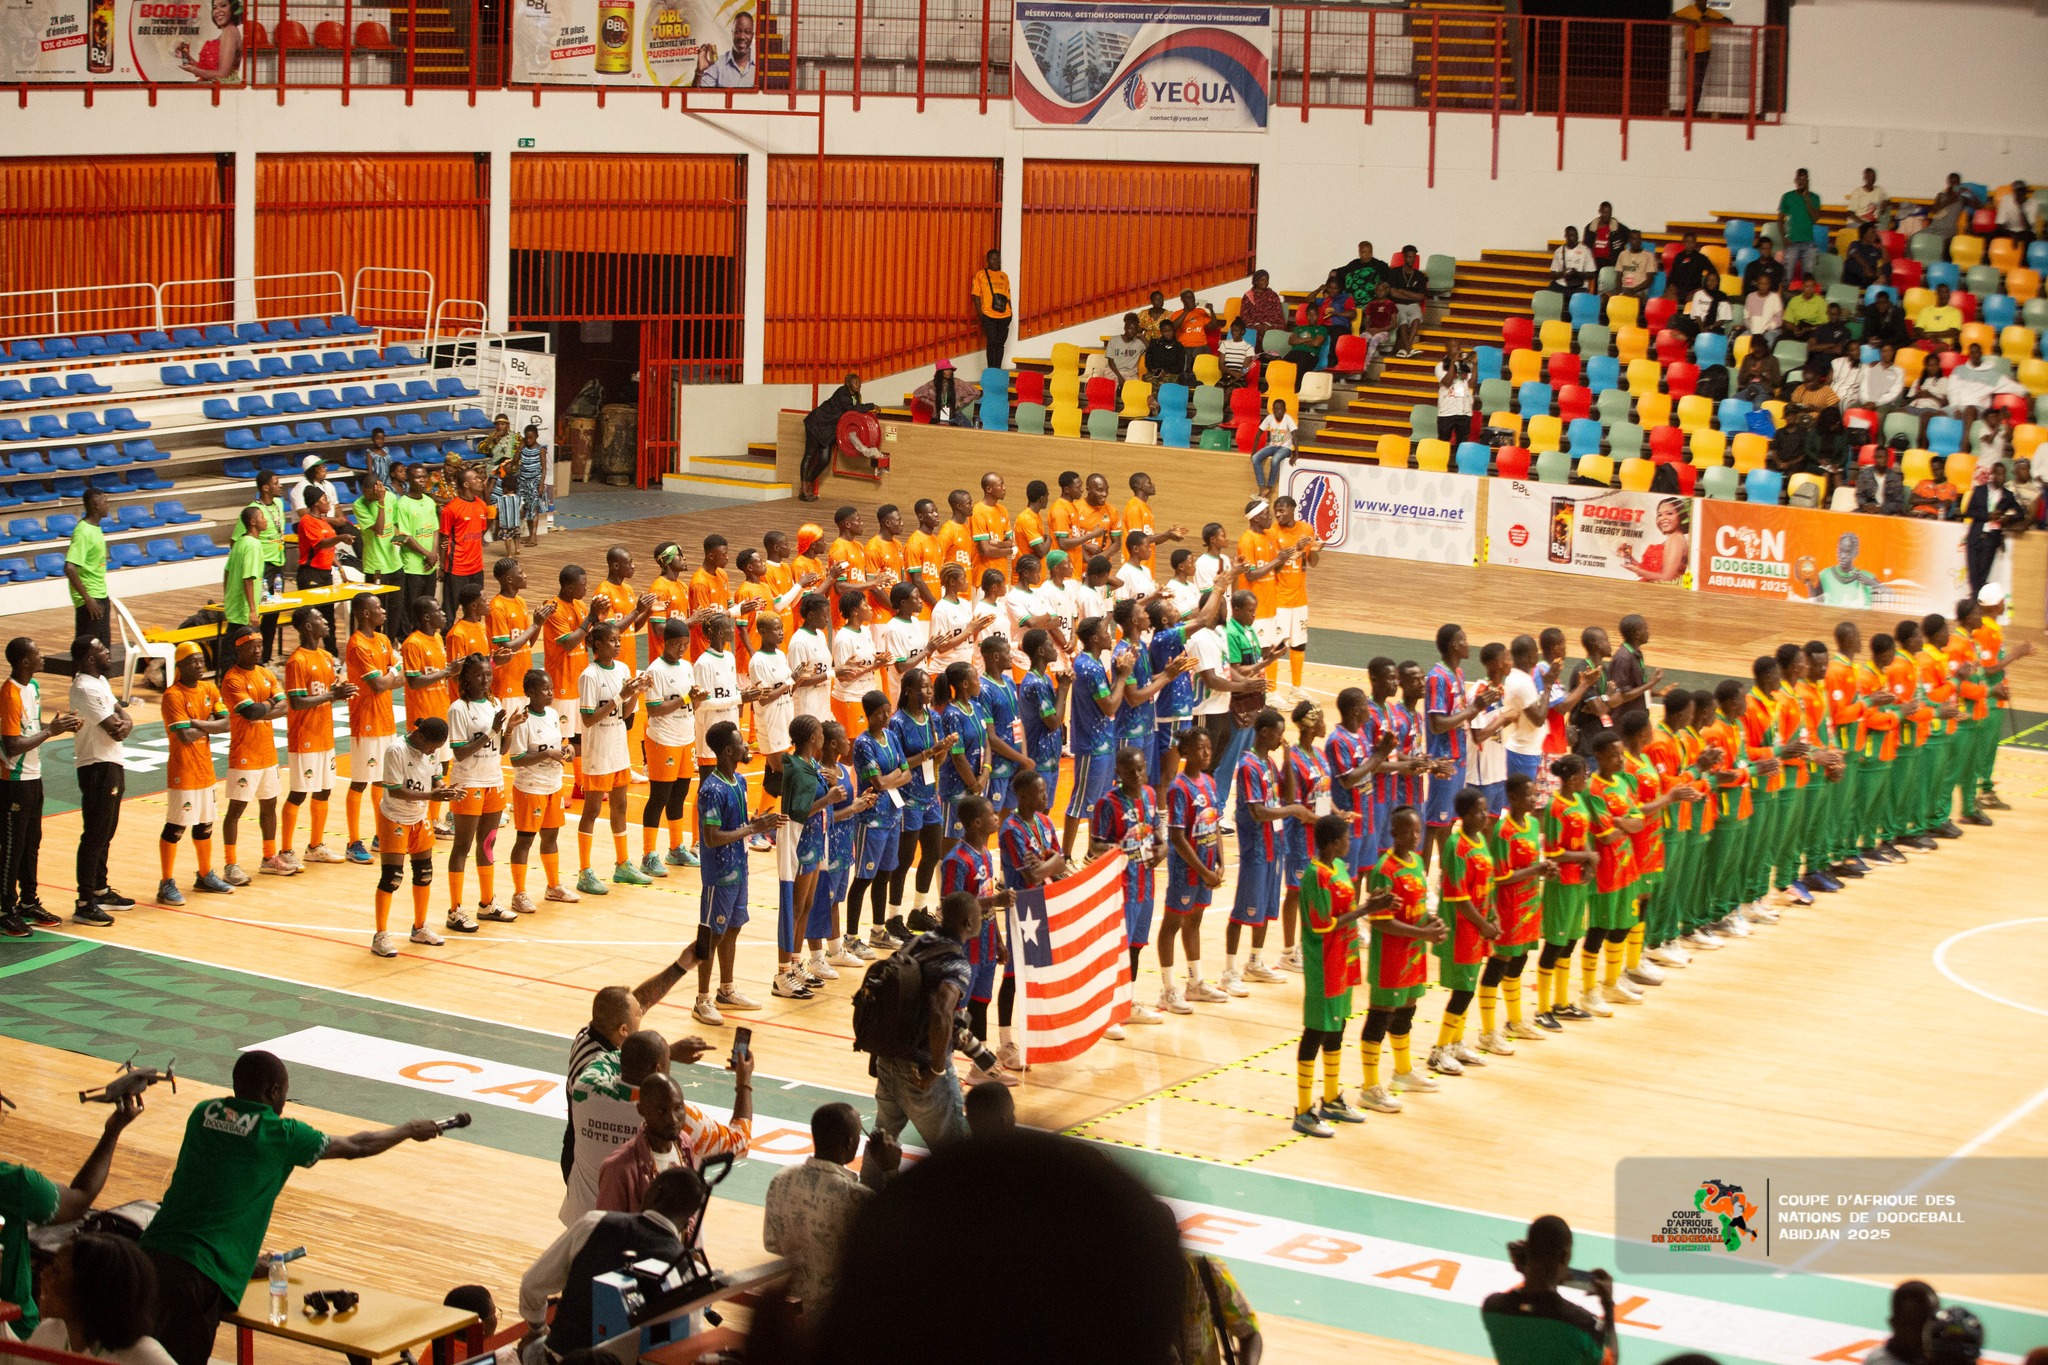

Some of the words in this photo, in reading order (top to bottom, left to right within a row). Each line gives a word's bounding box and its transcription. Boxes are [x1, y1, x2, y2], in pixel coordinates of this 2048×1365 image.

[140, 4, 201, 18] BOOST
[526, 0, 551, 14] BBL
[50, 16, 58, 25] 2X
[60, 14, 75, 24] plus
[660, 9, 683, 23] BBL
[1025, 9, 1073, 18] RÉSERVATION,
[1105, 11, 1144, 20] LOGISTIQUE
[1207, 14, 1261, 22] D'HÉBERGEMENT
[46, 24, 79, 37] d'énergie
[138, 26, 151, 35] BBL
[152, 26, 178, 35] ENERGY
[179, 27, 200, 35] DRINK
[560, 28, 570, 36] 2X
[570, 25, 586, 36] plus
[606, 19, 627, 32] BBL
[651, 24, 691, 40] TURBO
[44, 41, 54, 50] 0%
[56, 36, 84, 48] d'alcool
[556, 35, 589, 47] d'énergie
[650, 40, 678, 49] RESSENTEZ
[91, 48, 112, 66] BBL
[566, 46, 594, 56] d'alcool
[647, 47, 700, 58] PUISSANCE
[1151, 82, 1235, 106] YEQUA
[511, 358, 531, 376] BBL
[1512, 481, 1530, 496] BBL
[1354, 500, 1464, 520] www.yequa.net
[1583, 504, 1645, 522] BOOST
[1580, 524, 1593, 533] BBL
[1594, 526, 1620, 536] ENERGY
[1621, 529, 1644, 538] DRINK
[1552, 542, 1570, 558] BBL
[923, 562, 939, 578] BBL
[1714, 559, 1788, 577] DODGEBALL
[1708, 575, 1756, 589] ABIDJAN
[1760, 581, 1788, 592] 2025
[204, 1120, 246, 1135] DODGEBALL
[588, 1118, 638, 1135] DODGEBA
[582, 1127, 608, 1142] CÔTE
